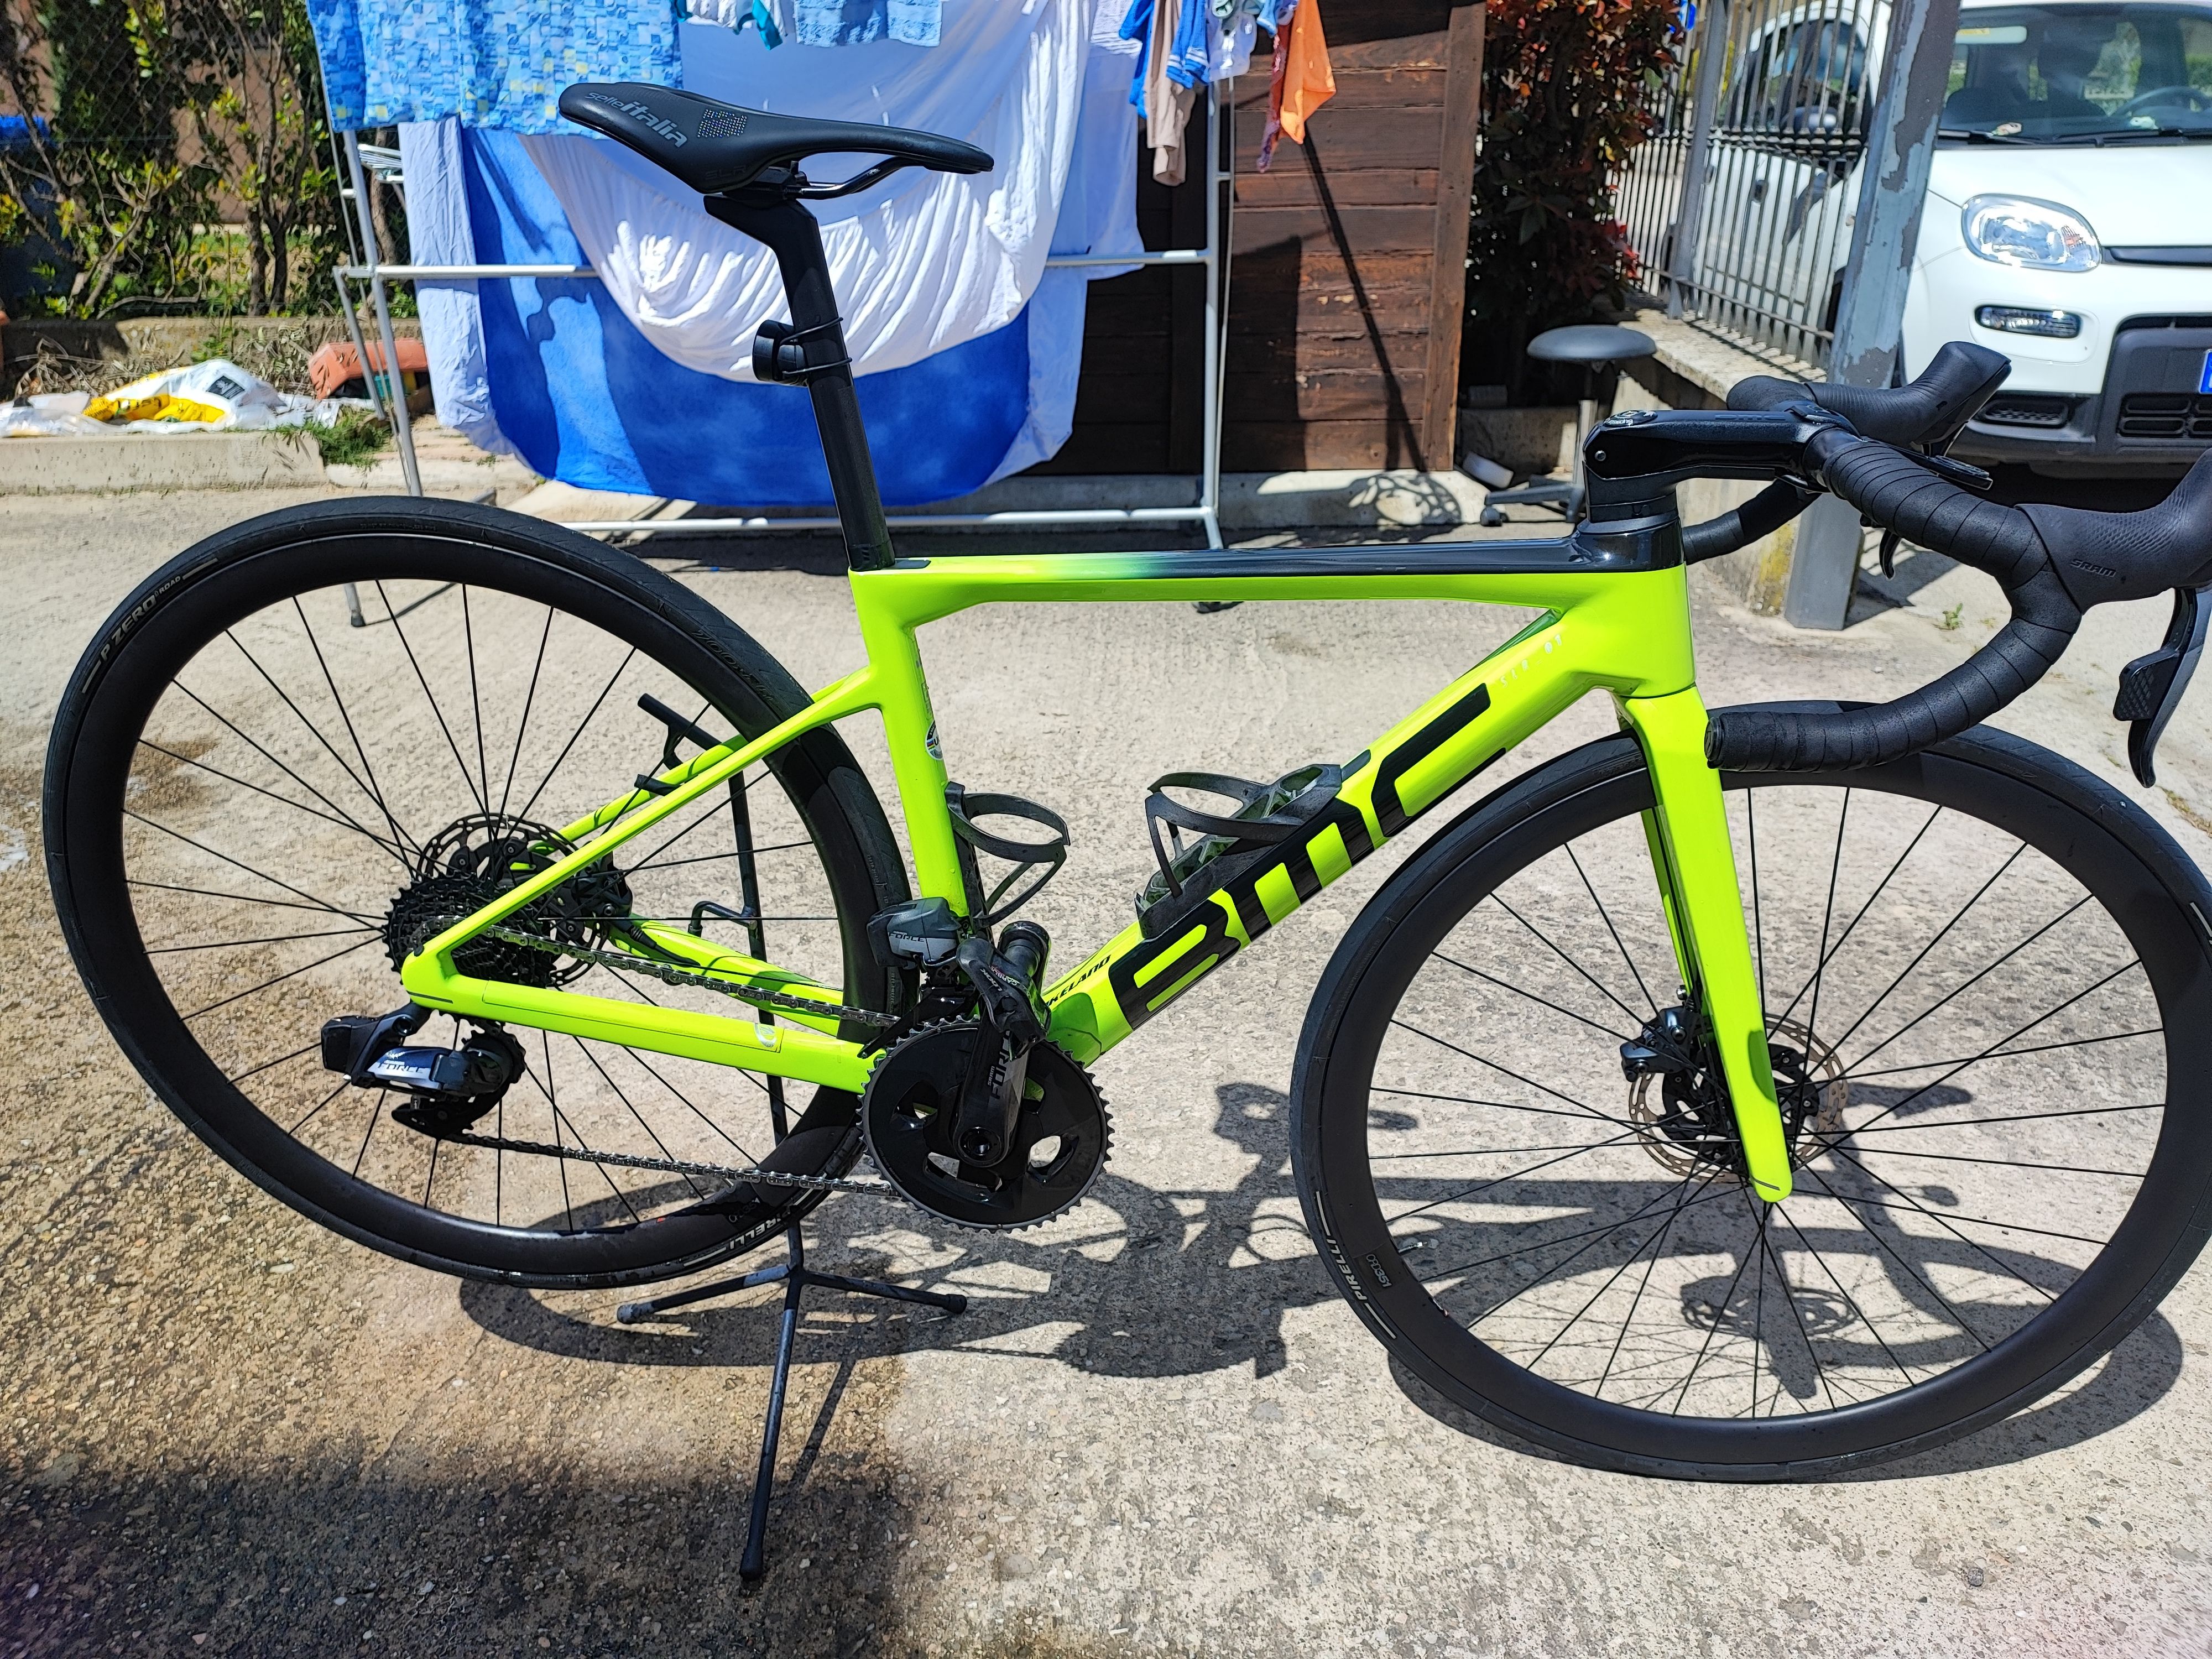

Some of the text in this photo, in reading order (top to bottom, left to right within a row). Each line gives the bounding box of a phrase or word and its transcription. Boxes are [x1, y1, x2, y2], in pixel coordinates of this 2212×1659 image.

[585, 92, 687, 148] selle italia
[2070, 557, 2117, 577] SRAM
[101, 576, 181, 662] P ZERO ROAD
[888, 931, 925, 942] FORCE
[979, 968, 1003, 992] LOOK
[1327, 1239, 1368, 1300] PIRELLI
